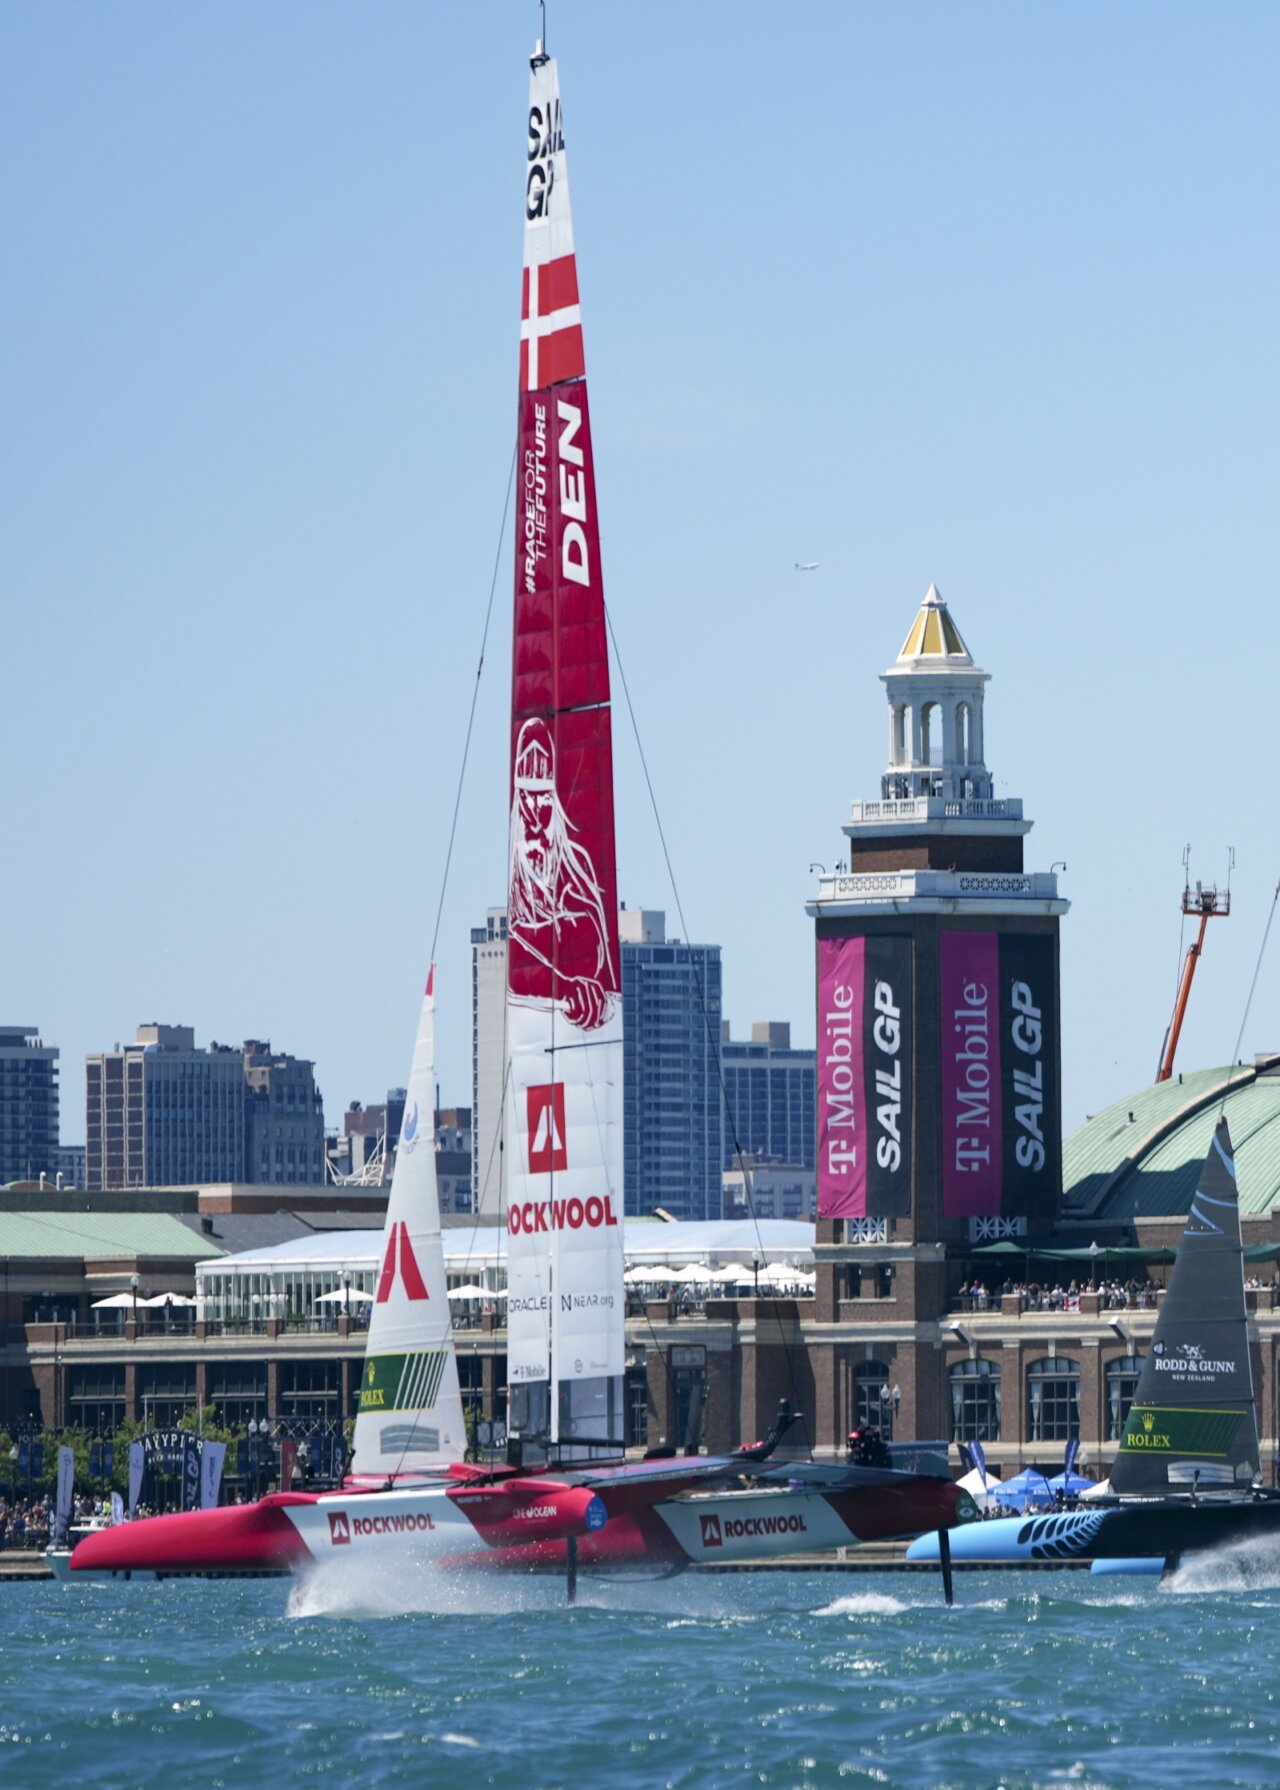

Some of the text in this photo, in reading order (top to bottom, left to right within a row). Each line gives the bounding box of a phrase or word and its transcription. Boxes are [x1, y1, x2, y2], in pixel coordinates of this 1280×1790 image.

[526, 164, 554, 221] GP
[557, 400, 590, 588] DEN
[873, 980, 900, 1172] SAIL GP
[1011, 980, 1045, 1172] SAIL GP
[509, 1297, 548, 1313] ORACLE
[1155, 1359, 1235, 1372] RODD & GUNN
[1187, 1374, 1215, 1382] ZEALAND
[1127, 1433, 1170, 1447] ROLEX
[352, 1513, 436, 1536] ROCKWOOL
[724, 1514, 808, 1538] ROCKWOOL
